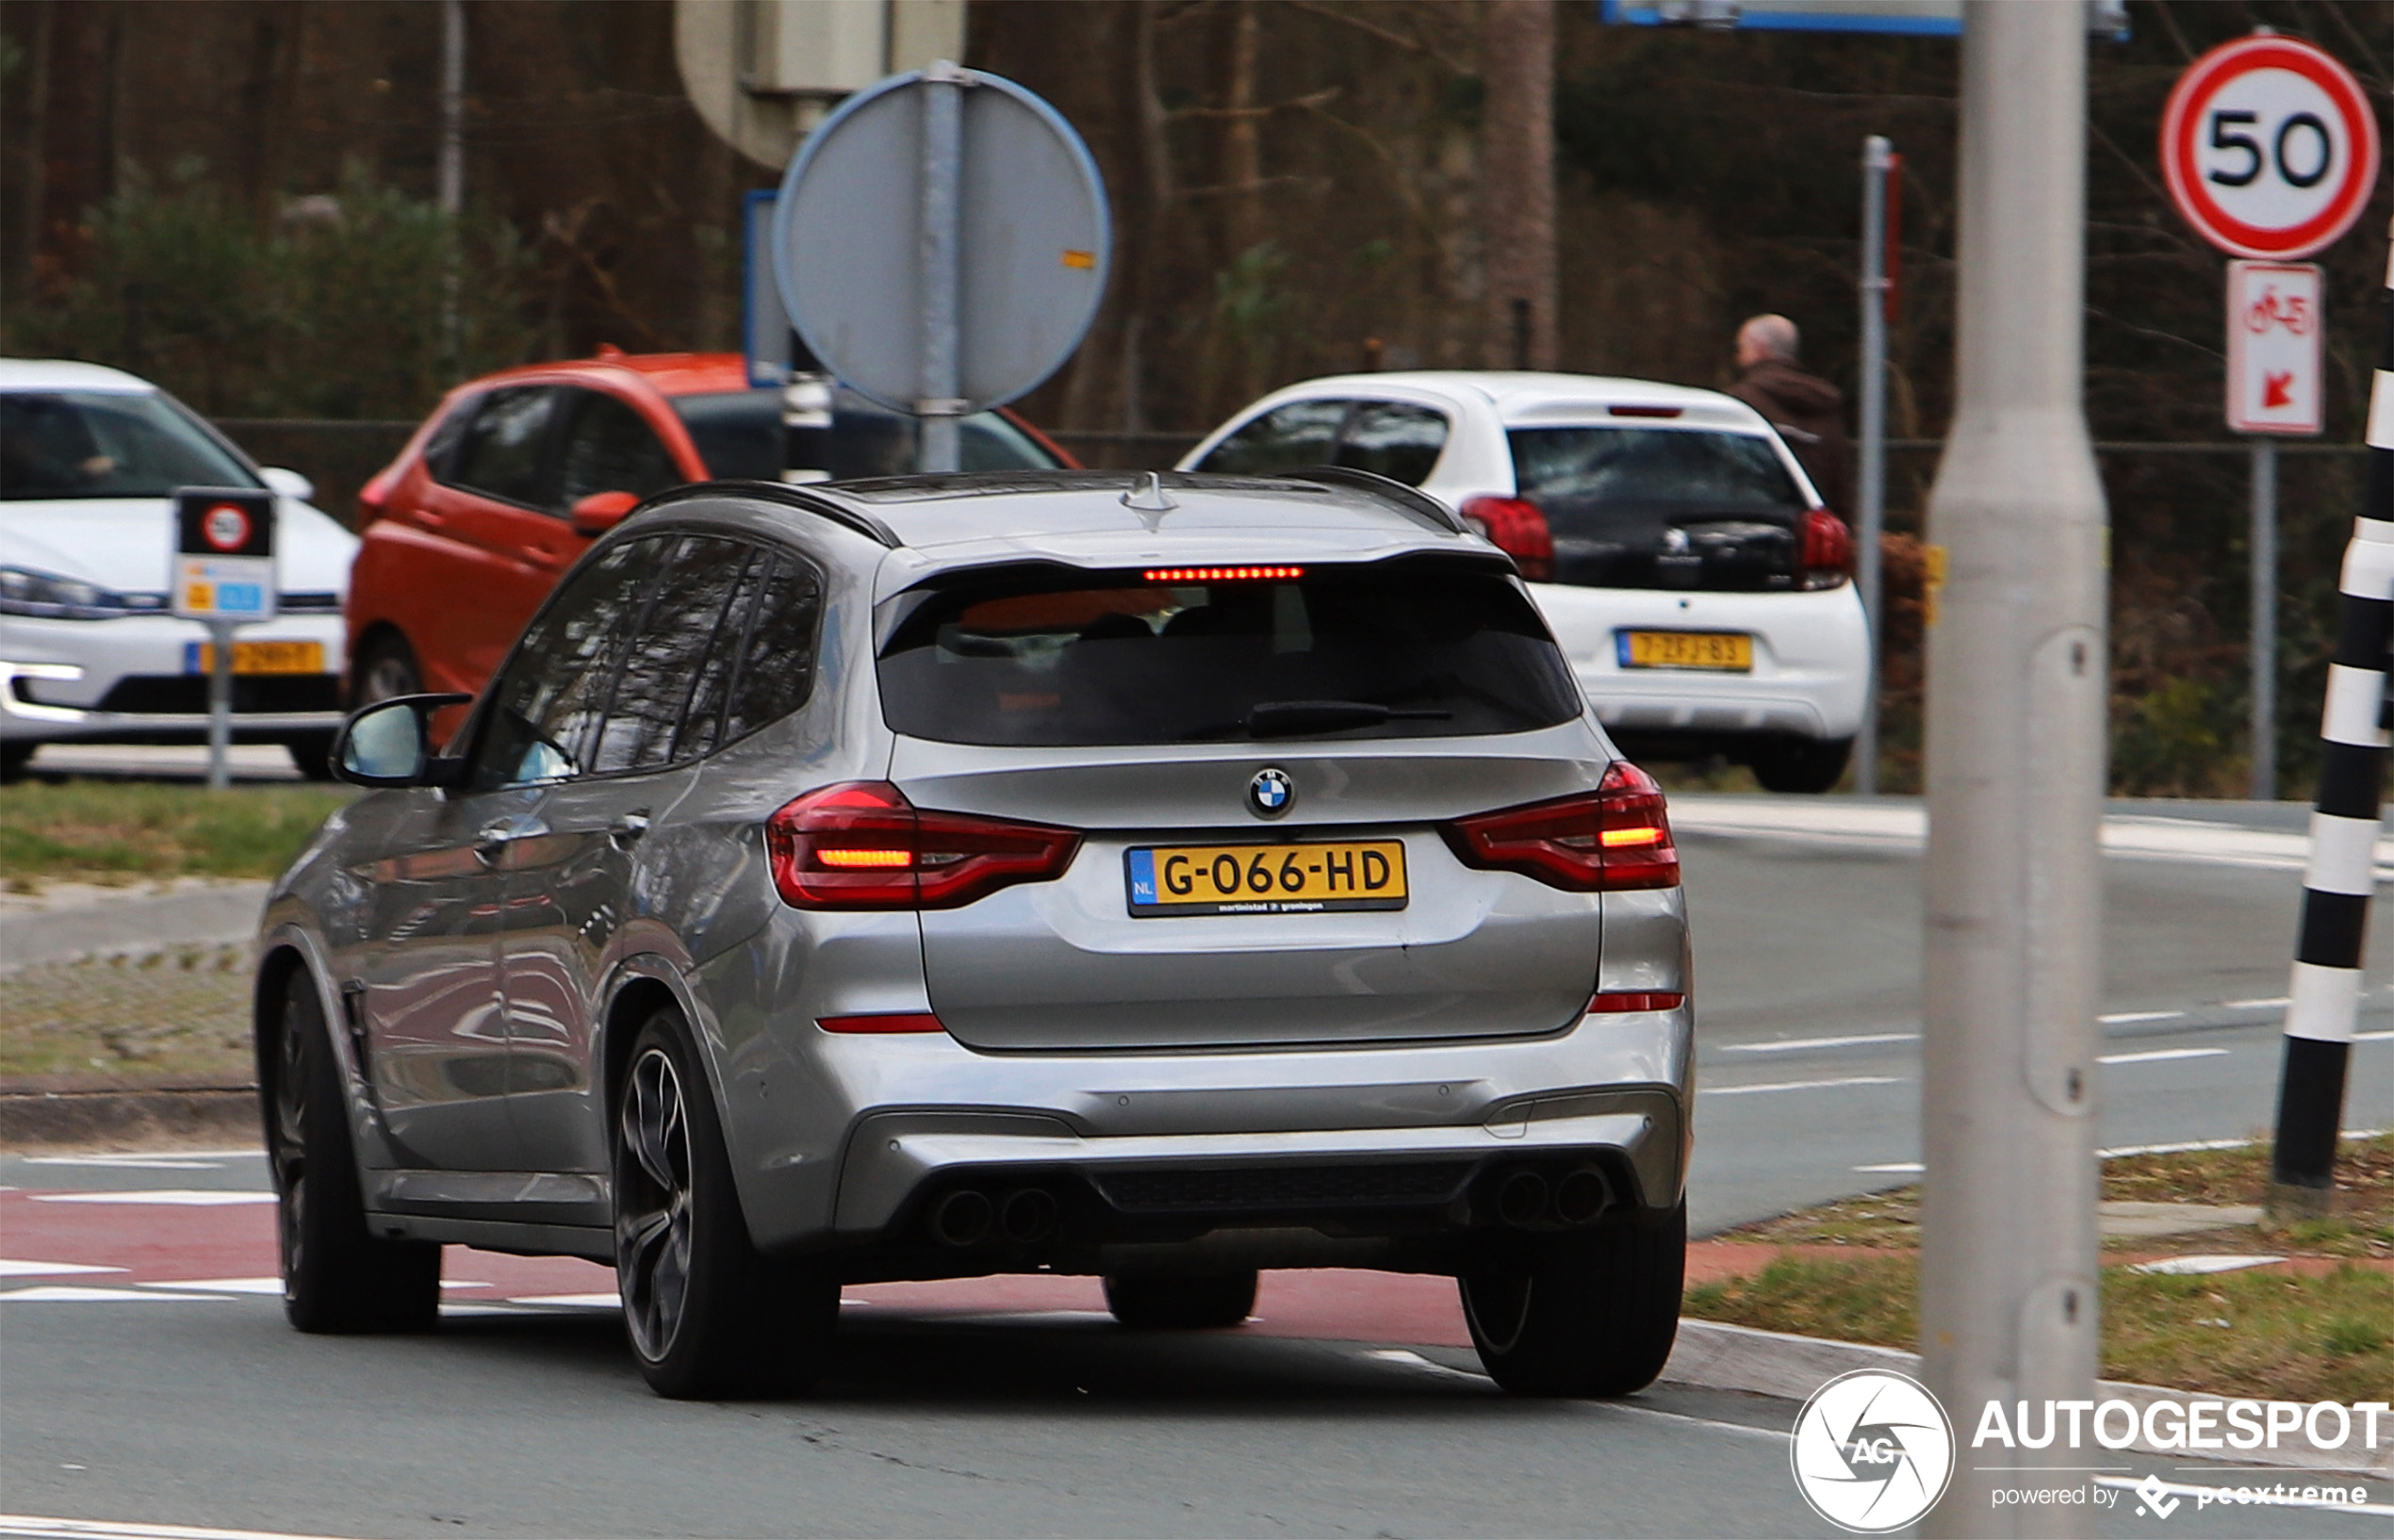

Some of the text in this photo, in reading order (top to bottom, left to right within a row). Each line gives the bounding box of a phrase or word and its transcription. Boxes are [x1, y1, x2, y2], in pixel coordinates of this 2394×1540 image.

[2208, 110, 2331, 188] 50
[1134, 882, 1154, 894] NL
[1164, 850, 1390, 895] G-066-HD
